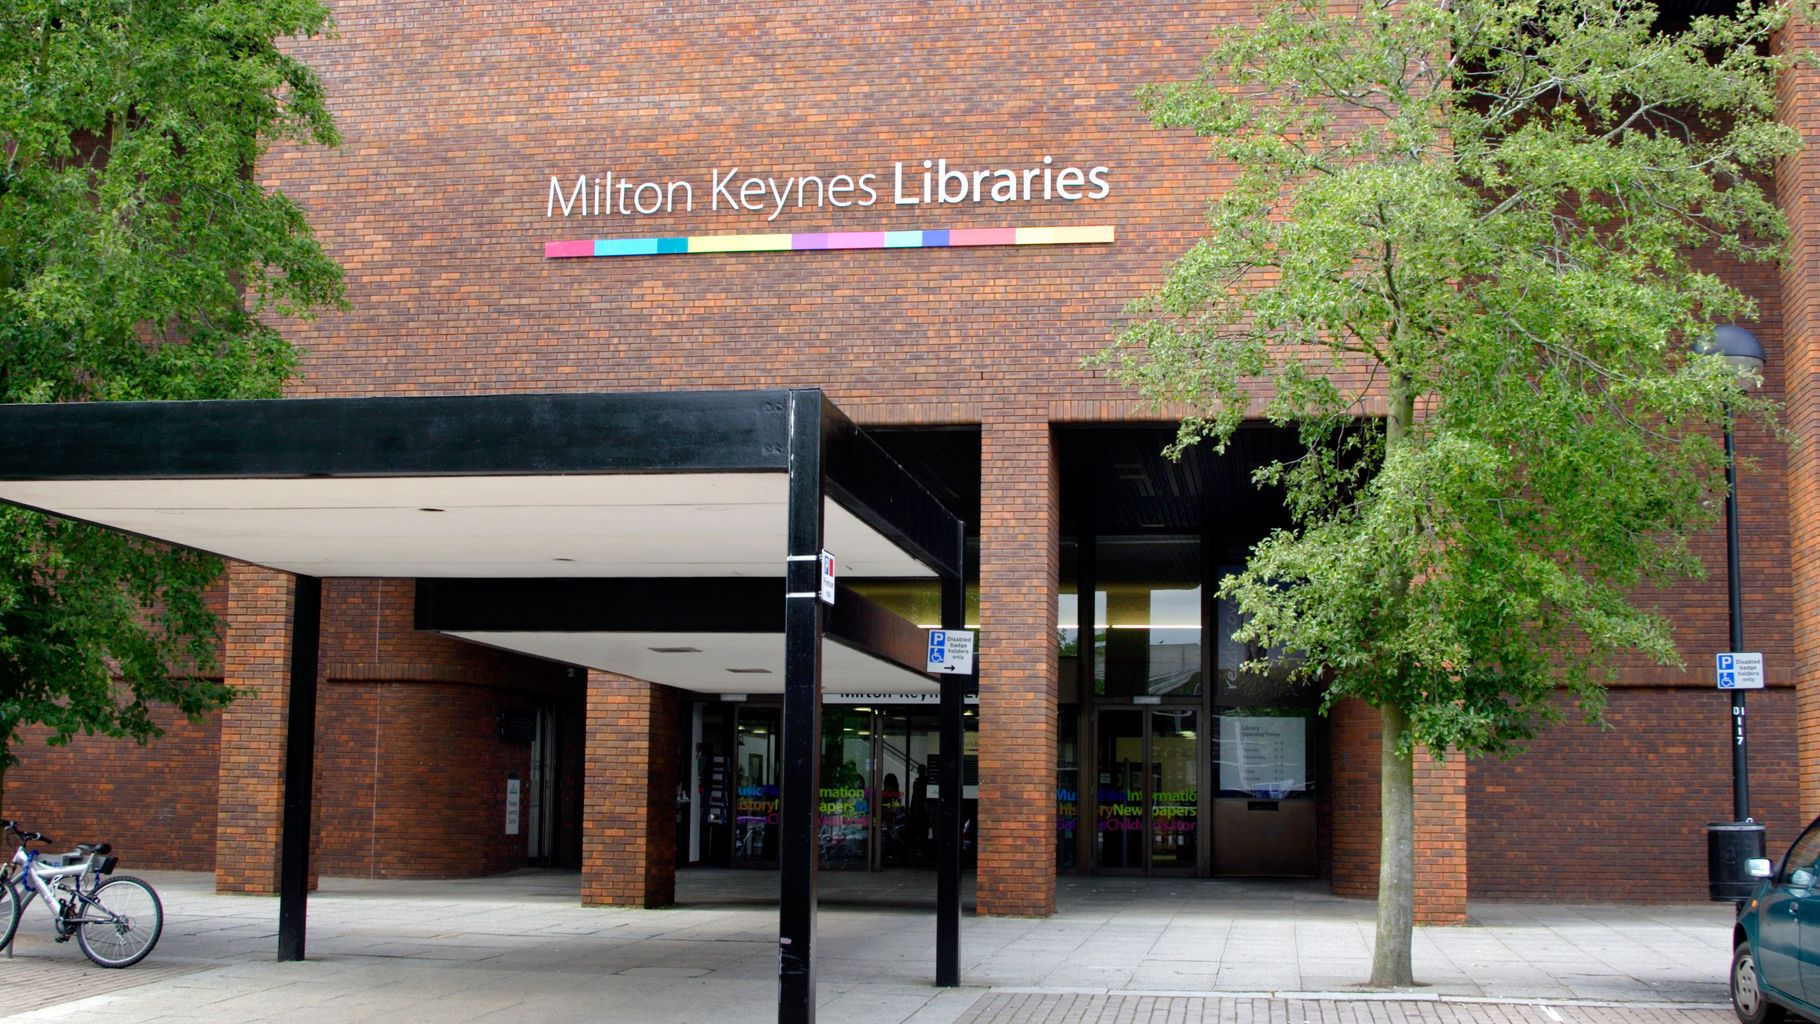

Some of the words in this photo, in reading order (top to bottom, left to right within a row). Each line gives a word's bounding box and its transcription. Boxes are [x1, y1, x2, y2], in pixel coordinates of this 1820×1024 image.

[547, 171, 693, 217] Milton
[712, 167, 877, 221] Keynes
[894, 155, 1110, 204] Libraries
[737, 784, 763, 797] usic
[819, 786, 864, 798] mation
[819, 801, 855, 815] apers
